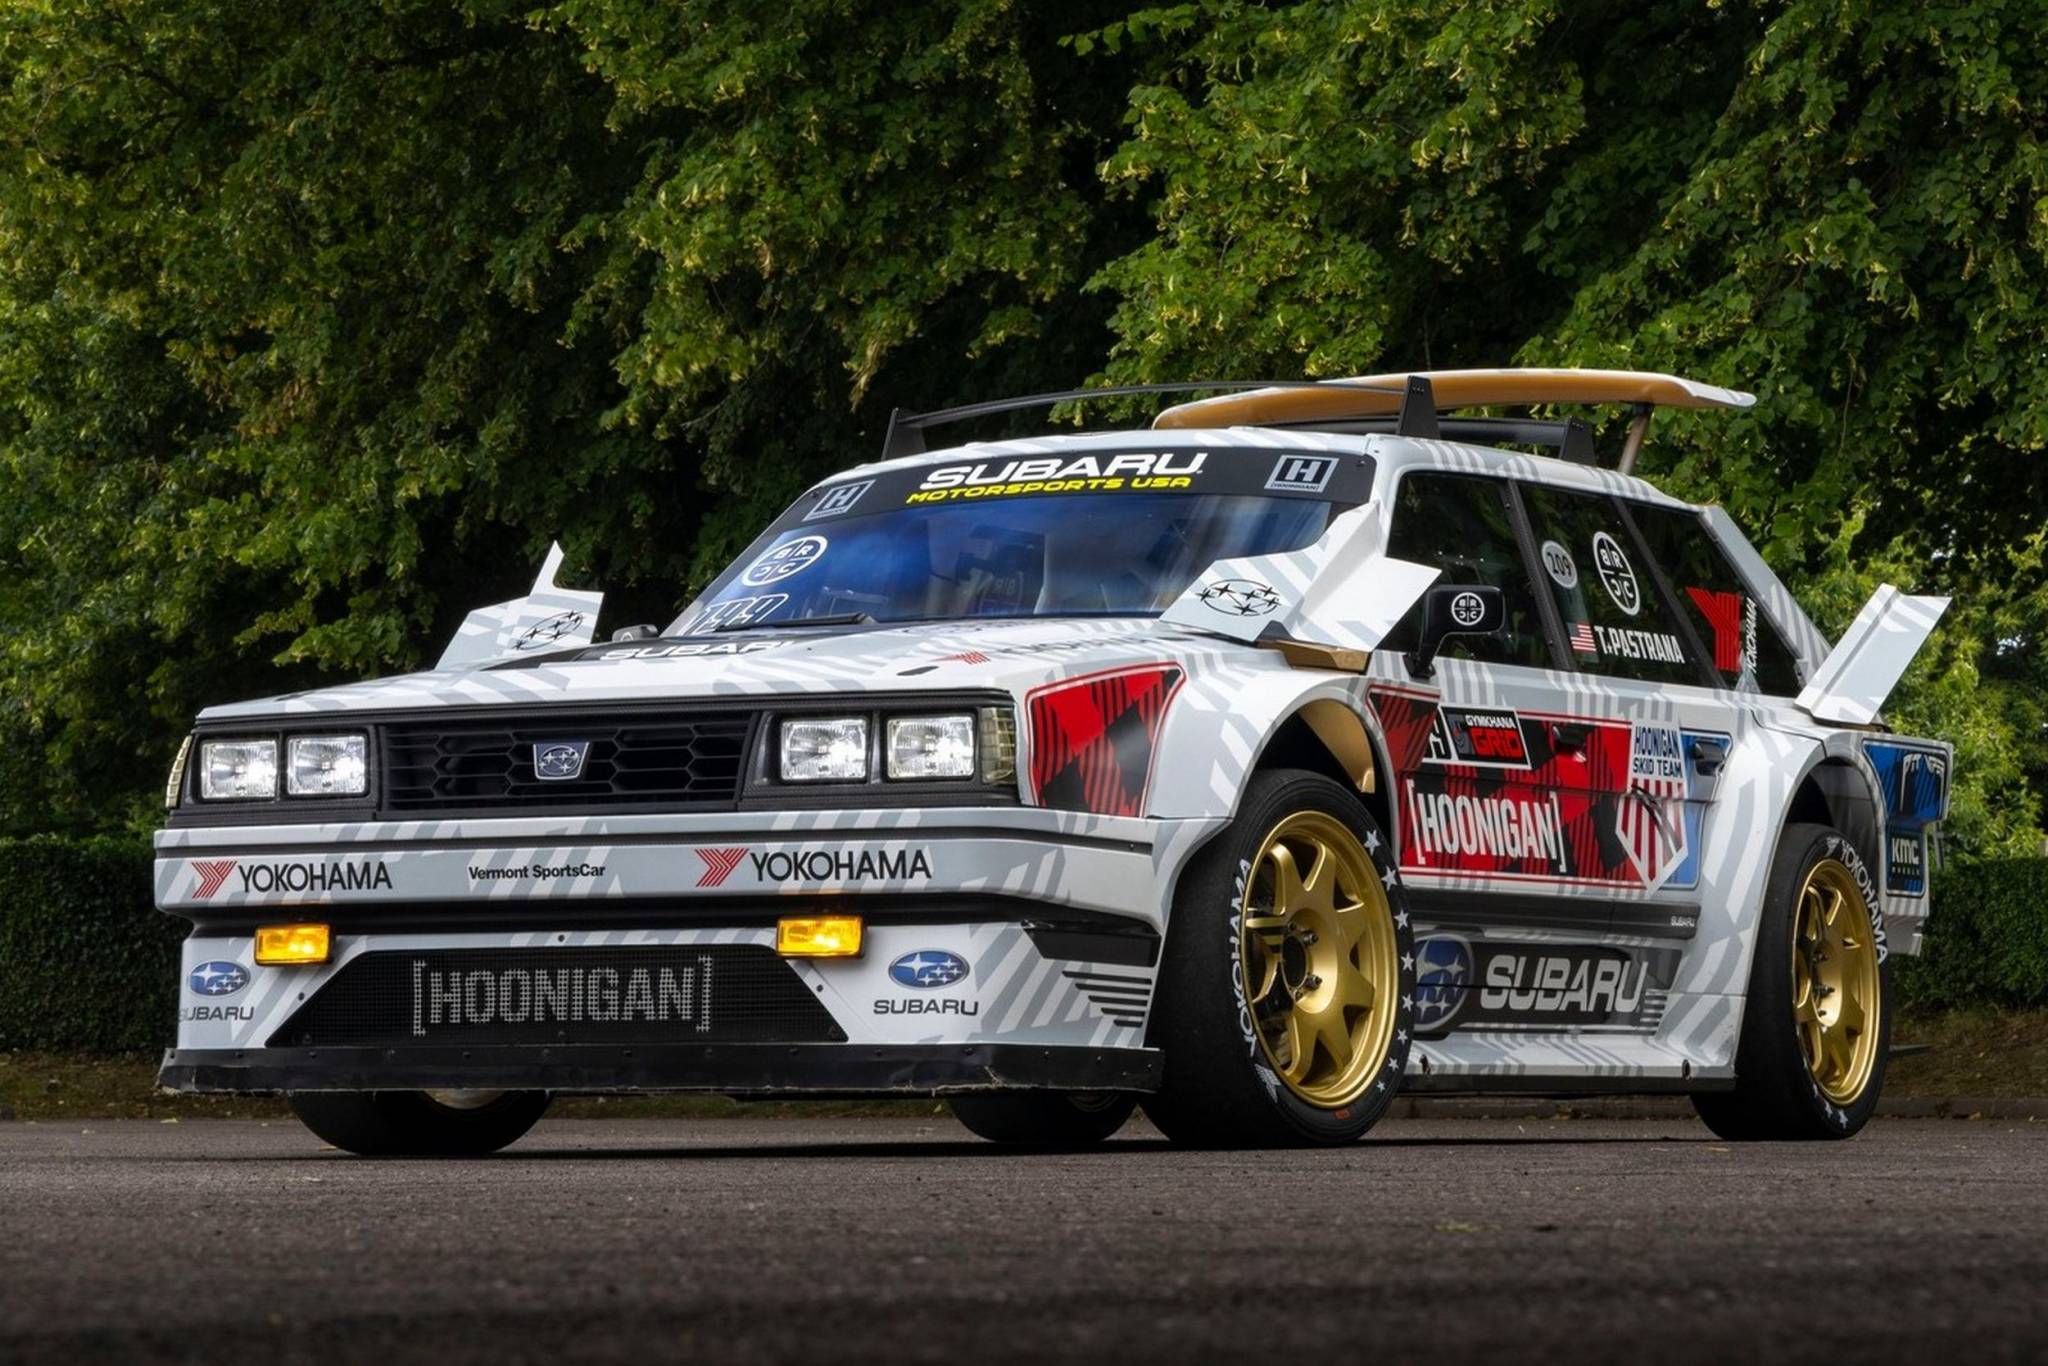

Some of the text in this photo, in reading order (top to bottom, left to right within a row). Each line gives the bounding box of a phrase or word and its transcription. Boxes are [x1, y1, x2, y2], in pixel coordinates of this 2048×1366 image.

[919, 453, 1206, 491] SUBARU
[906, 476, 1191, 504] MOTORSPORTS USA
[1594, 625, 1685, 665] T.PASTRANA
[1634, 725, 1680, 759] HOONIGAN
[1633, 757, 1683, 778] SKID TEAM
[750, 849, 932, 882] YOKOHAMA
[1891, 837, 1920, 865] KMC
[237, 860, 393, 894] YOKOHAMA
[468, 863, 606, 881] Vermont SportsCar
[1841, 840, 1888, 965] YOKOHAMA
[1229, 858, 1258, 1057] YOKOHAMA
[1480, 955, 1649, 1013] SUBARU
[873, 998, 979, 1017] SUBARU
